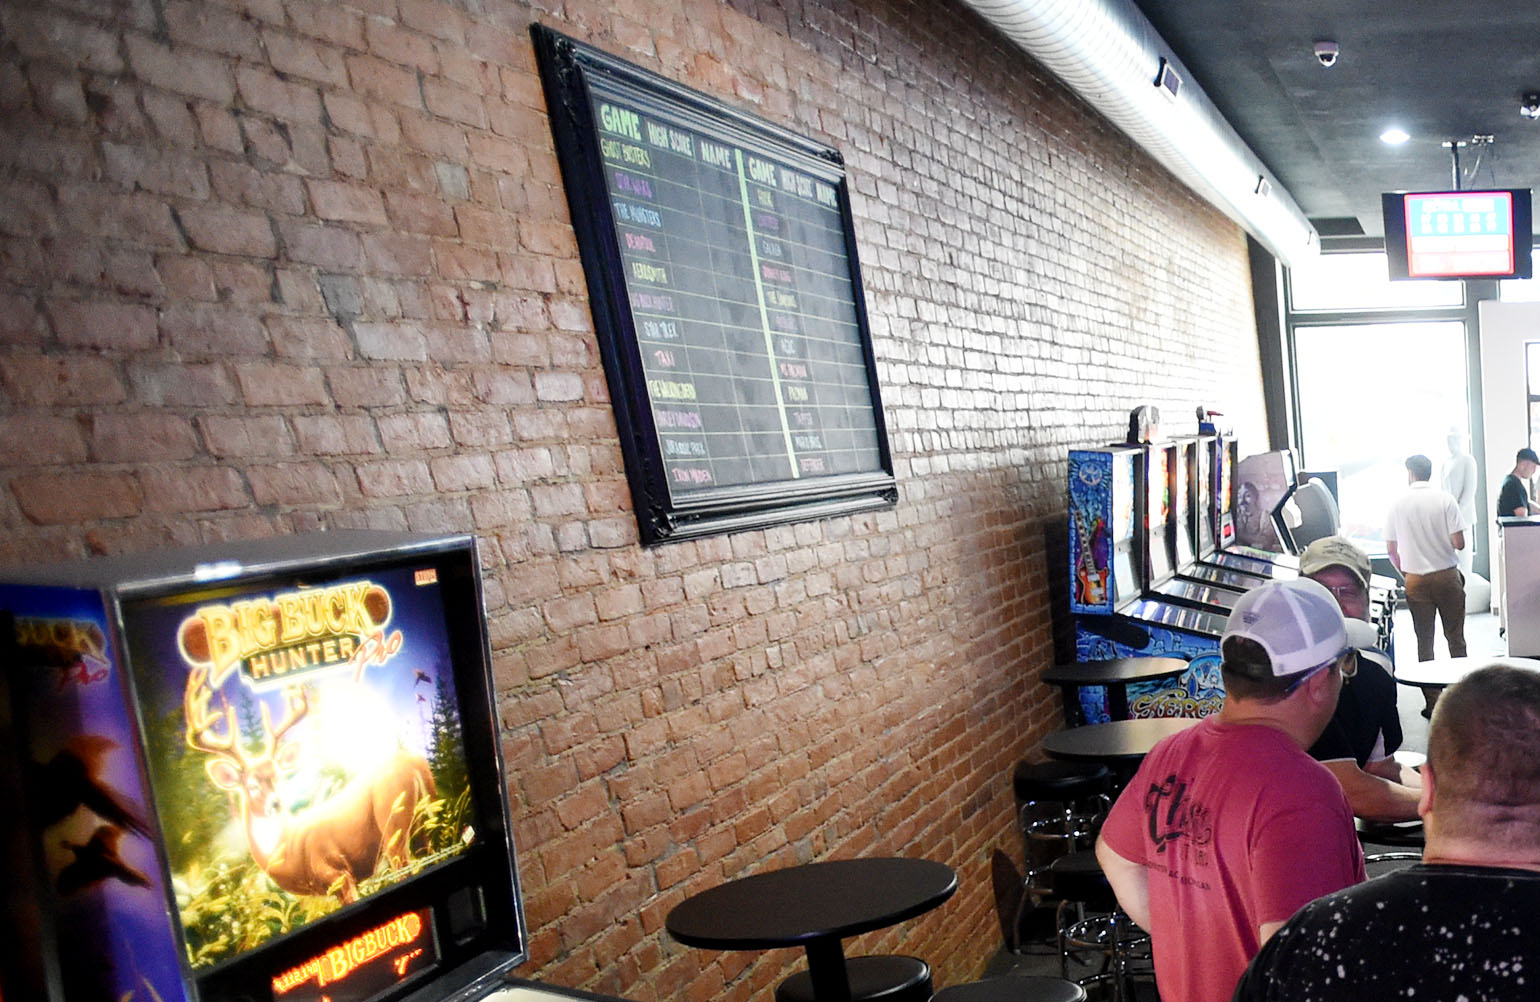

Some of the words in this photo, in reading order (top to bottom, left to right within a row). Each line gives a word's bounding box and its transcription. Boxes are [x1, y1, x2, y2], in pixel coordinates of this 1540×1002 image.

[601, 104, 641, 140] GAME
[700, 141, 732, 169] NAME
[749, 157, 777, 188] GAME
[199, 597, 277, 686] BIG
[276, 580, 376, 641] BUCK
[250, 636, 357, 680] HUNTER
[349, 630, 403, 682] Pro
